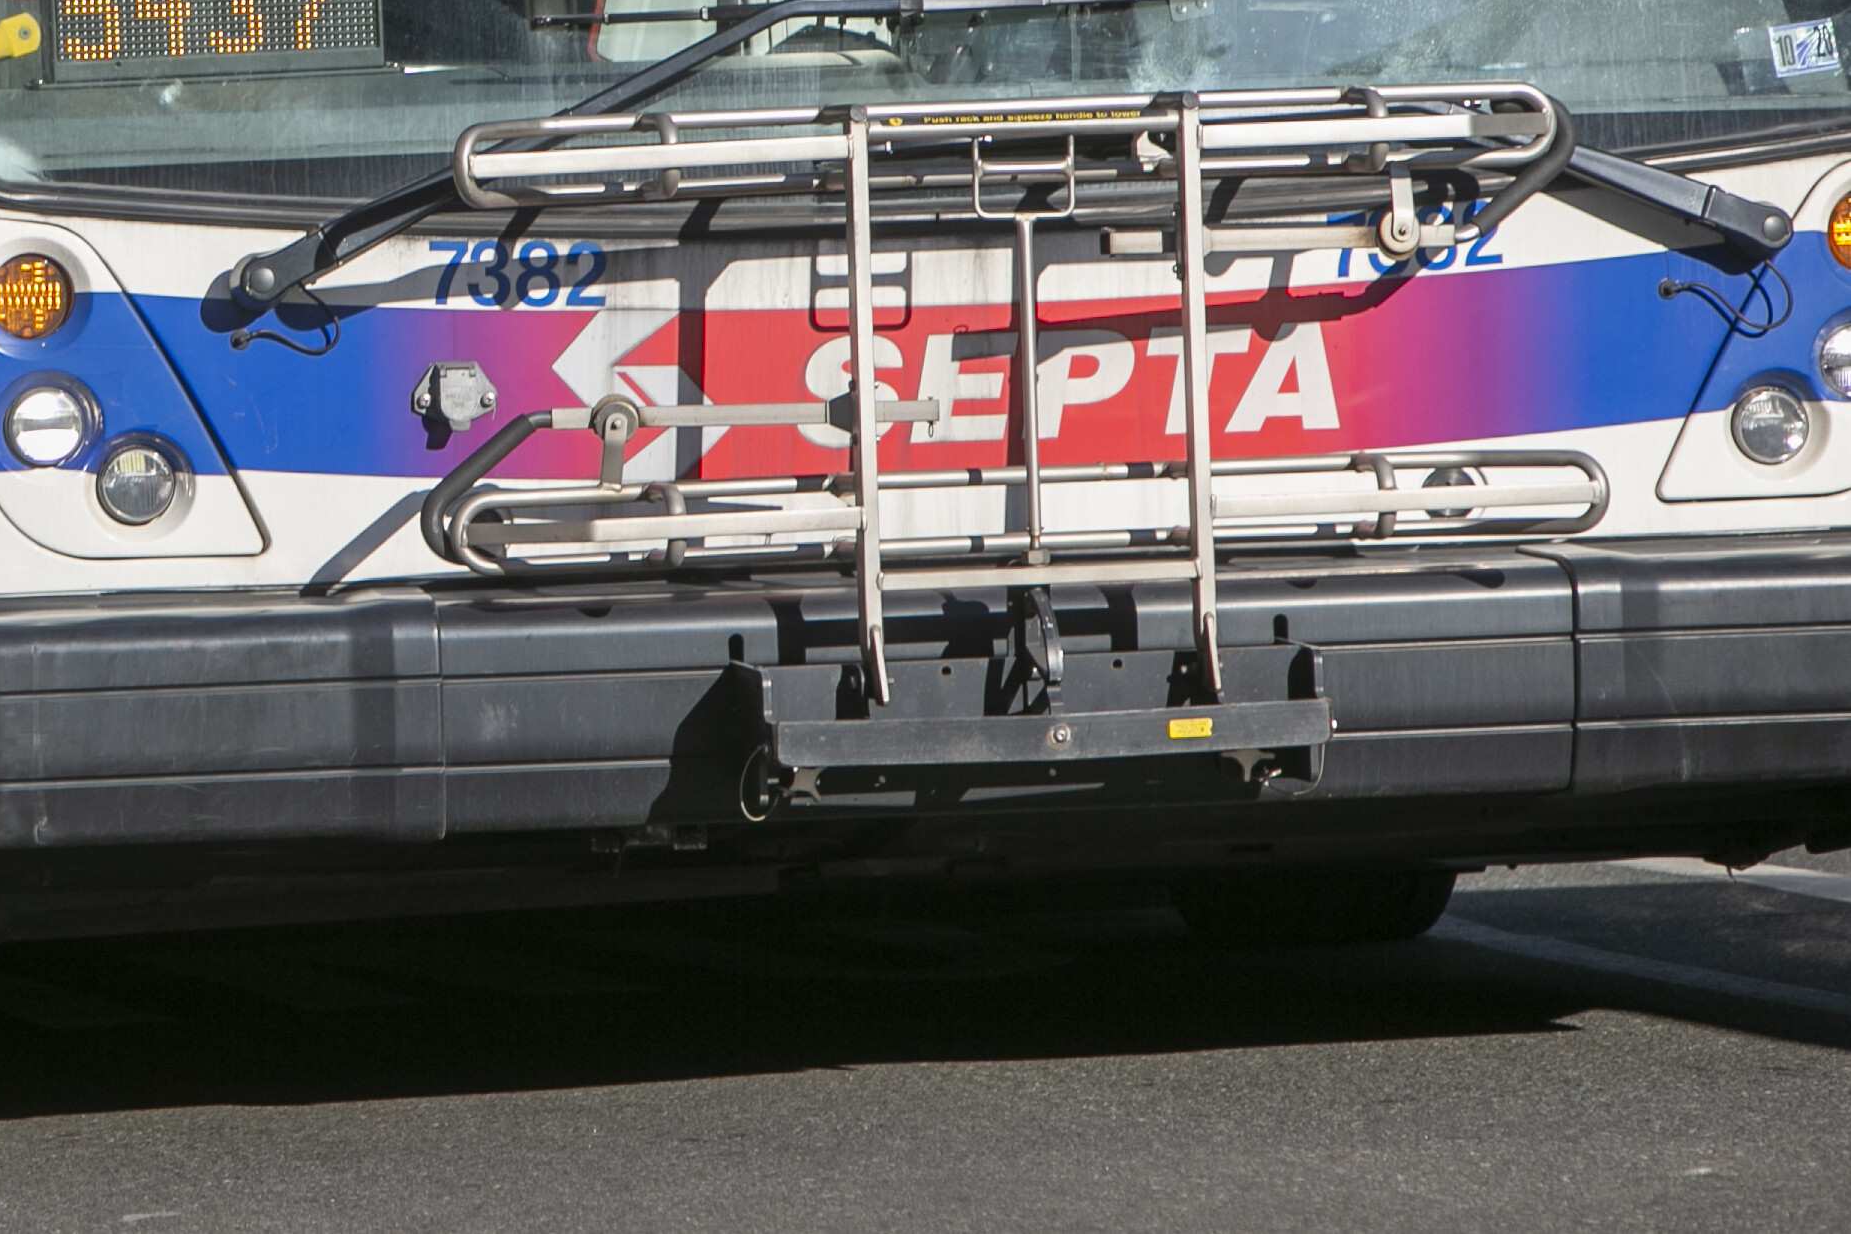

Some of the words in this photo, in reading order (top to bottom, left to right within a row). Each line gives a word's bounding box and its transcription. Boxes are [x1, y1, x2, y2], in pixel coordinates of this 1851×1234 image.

[923, 115, 953, 125] Push
[955, 114, 980, 124] rack
[983, 113, 1004, 123] and
[1006, 113, 1053, 124] squeeze
[1055, 110, 1093, 121] handle
[1096, 110, 1108, 119] to
[1110, 109, 1142, 119] lower
[429, 240, 606, 308] 7382
[795, 321, 1341, 449] SEPTA
